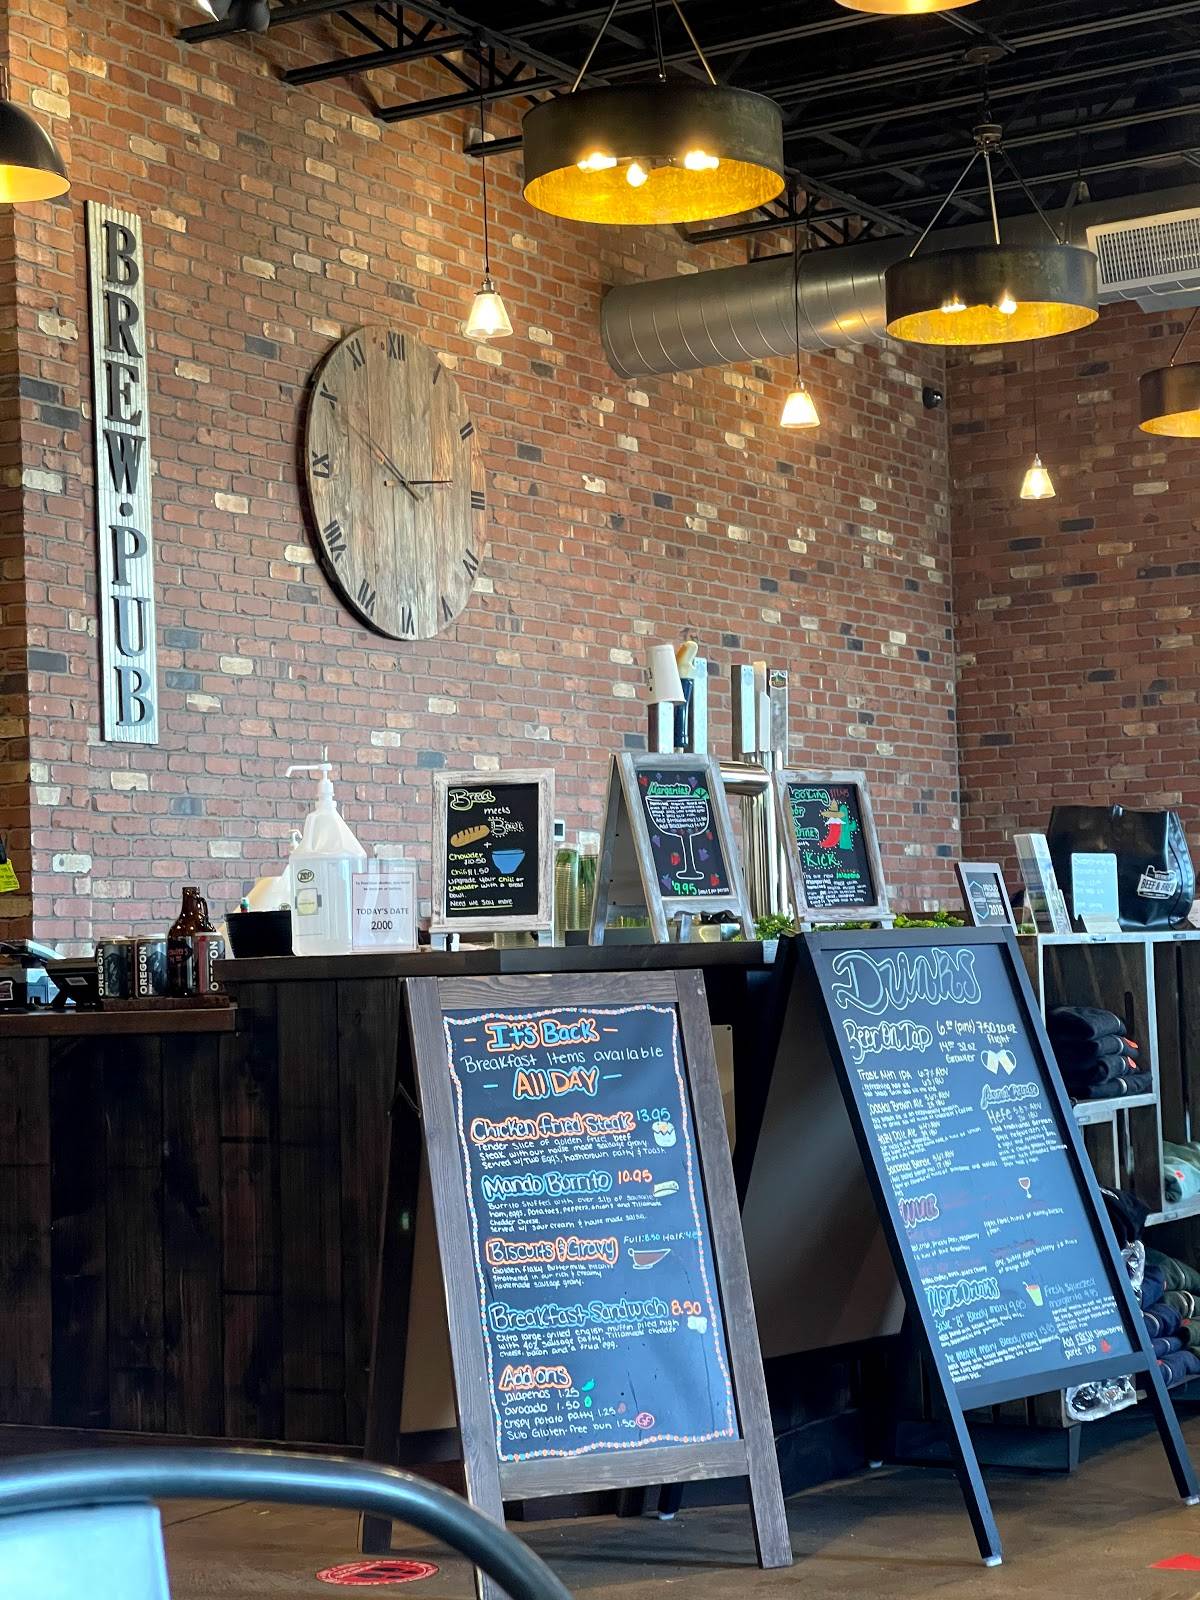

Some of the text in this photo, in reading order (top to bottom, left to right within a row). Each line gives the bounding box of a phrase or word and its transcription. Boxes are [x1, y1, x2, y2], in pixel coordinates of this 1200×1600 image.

[449, 789, 496, 811] Bread
[484, 806, 511, 815] meets
[449, 852, 483, 860] Chowder
[989, 904, 1004, 915] 2019
[371, 920, 393, 930] 2000
[139, 946, 147, 994] OREGON
[540, 1018, 599, 1046] Back
[460, 1047, 664, 1073] Breakfast Items available
[513, 1067, 599, 1099] All DAY
[472, 1108, 671, 1143] Chicken Steak 13.95
[475, 1143, 508, 1151] Tender
[555, 1137, 582, 1147] golden
[613, 1133, 631, 1141] beef
[627, 1140, 647, 1149] gravy
[482, 1170, 653, 1202] Mando Burrito 10.95
[487, 1238, 556, 1265] Biscuits
[567, 1236, 618, 1265] Gravy
[488, 1298, 701, 1332] Breakfast Sandwich 8.50
[607, 1324, 633, 1332] muffin
[637, 1320, 657, 1330] piled
[660, 1319, 679, 1327] high
[499, 1365, 536, 1390] Add
[558, 1388, 580, 1398] 1.25
[505, 1400, 580, 1415] avocado 1.50
[598, 1408, 615, 1417] 1.25
[617, 1420, 636, 1428] 1.50
